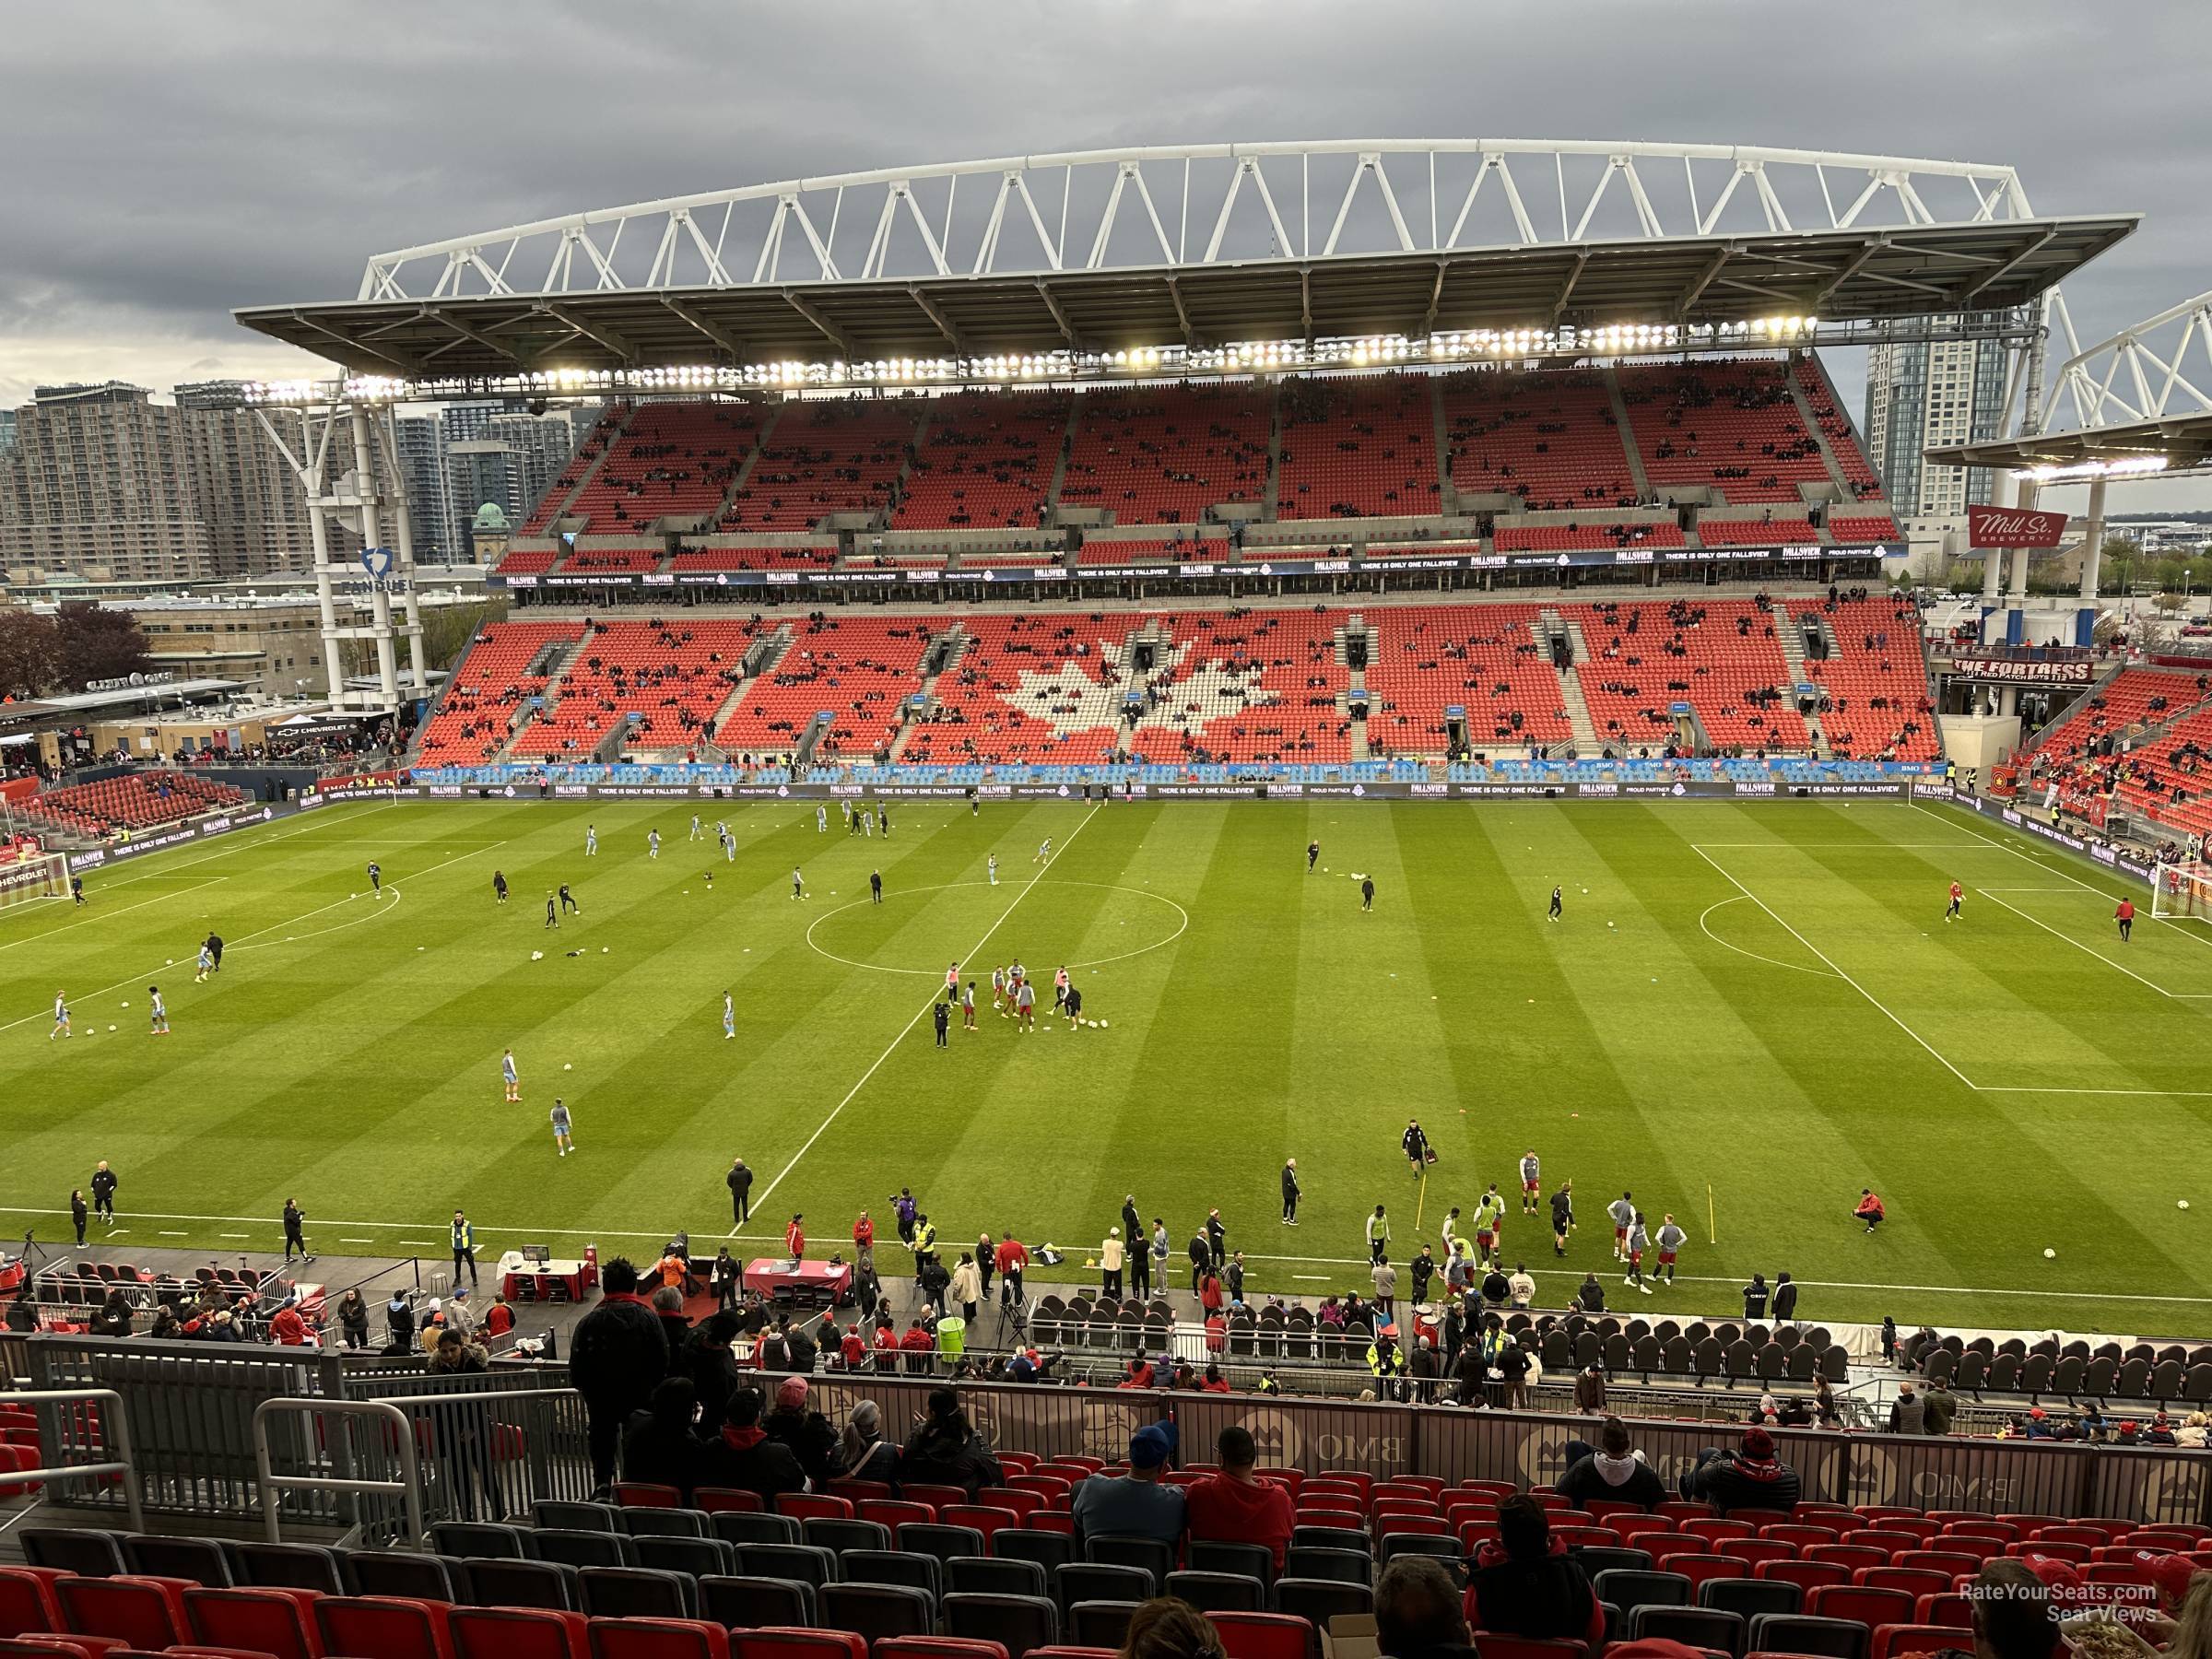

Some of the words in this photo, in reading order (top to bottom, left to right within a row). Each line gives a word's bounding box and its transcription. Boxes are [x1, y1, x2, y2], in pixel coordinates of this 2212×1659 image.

[1976, 513, 2022, 534] Mill
[2026, 515, 2053, 534] St.
[1616, 551, 1653, 560] FALLSVIEW
[1783, 547, 1821, 556] FALLSVIEW
[1471, 556, 1507, 565] FALLSVIEW
[1181, 565, 1214, 573] FALLSVIEW
[1315, 561, 1349, 571] FALLSVIEW
[1034, 569, 1067, 577] FALLSVIEW
[642, 575, 673, 583] FALLSVIEW
[340, 579, 417, 594] FANDUEL
[1954, 659, 1985, 672] THE
[1988, 661, 2089, 680] FORTRESS
[1998, 672, 2027, 680] PATCH
[301, 724, 347, 734] CHEVROLET
[830, 785, 863, 794] FALLSVIEW
[978, 785, 1011, 794] FALLSVIEW
[1411, 784, 1448, 793] FALLSVIEW
[1735, 783, 1775, 792] FALLSVIEW
[113, 848, 133, 856] THERE
[140, 840, 155, 849] ONLY
[156, 837, 167, 845] ONE
[168, 830, 194, 843] FALLSVIEW
[0, 868, 47, 887] HEVROLET
